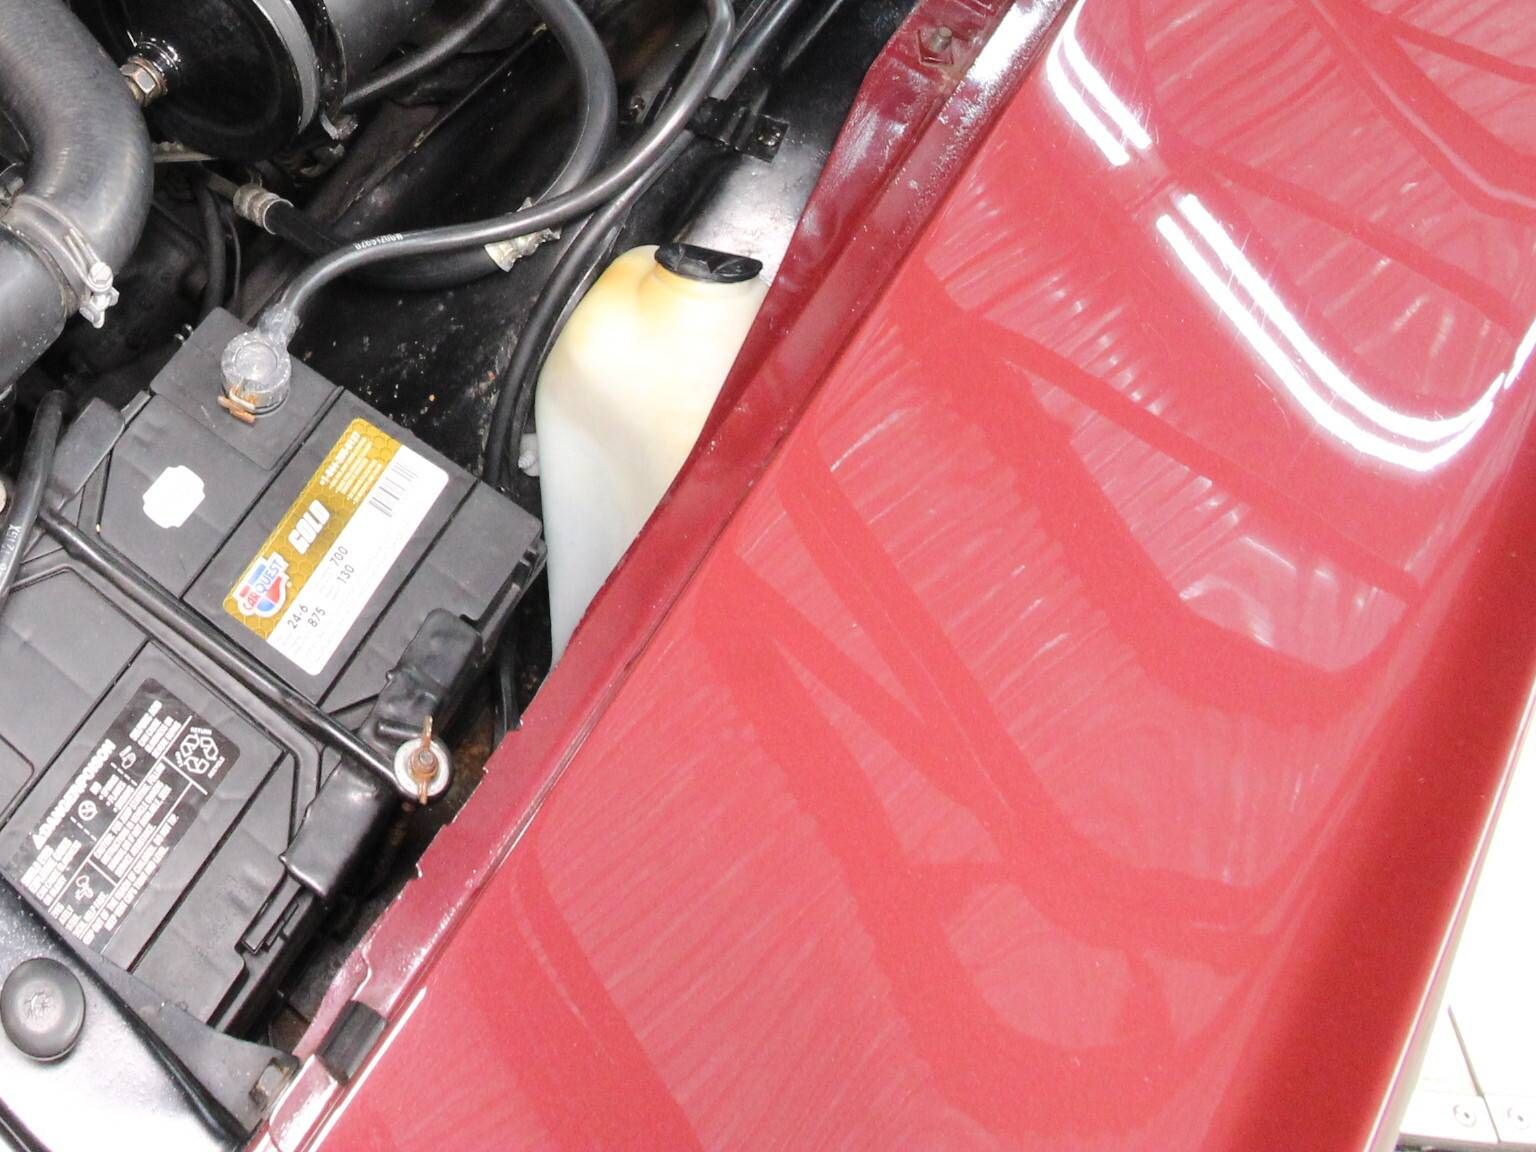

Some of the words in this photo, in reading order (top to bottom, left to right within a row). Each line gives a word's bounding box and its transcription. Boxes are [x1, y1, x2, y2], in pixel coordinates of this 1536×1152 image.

[288, 499, 330, 554] GOLD
[329, 545, 348, 566] 700
[337, 564, 355, 584] 130
[287, 604, 309, 629] 24-6
[308, 606, 326, 628] 875
